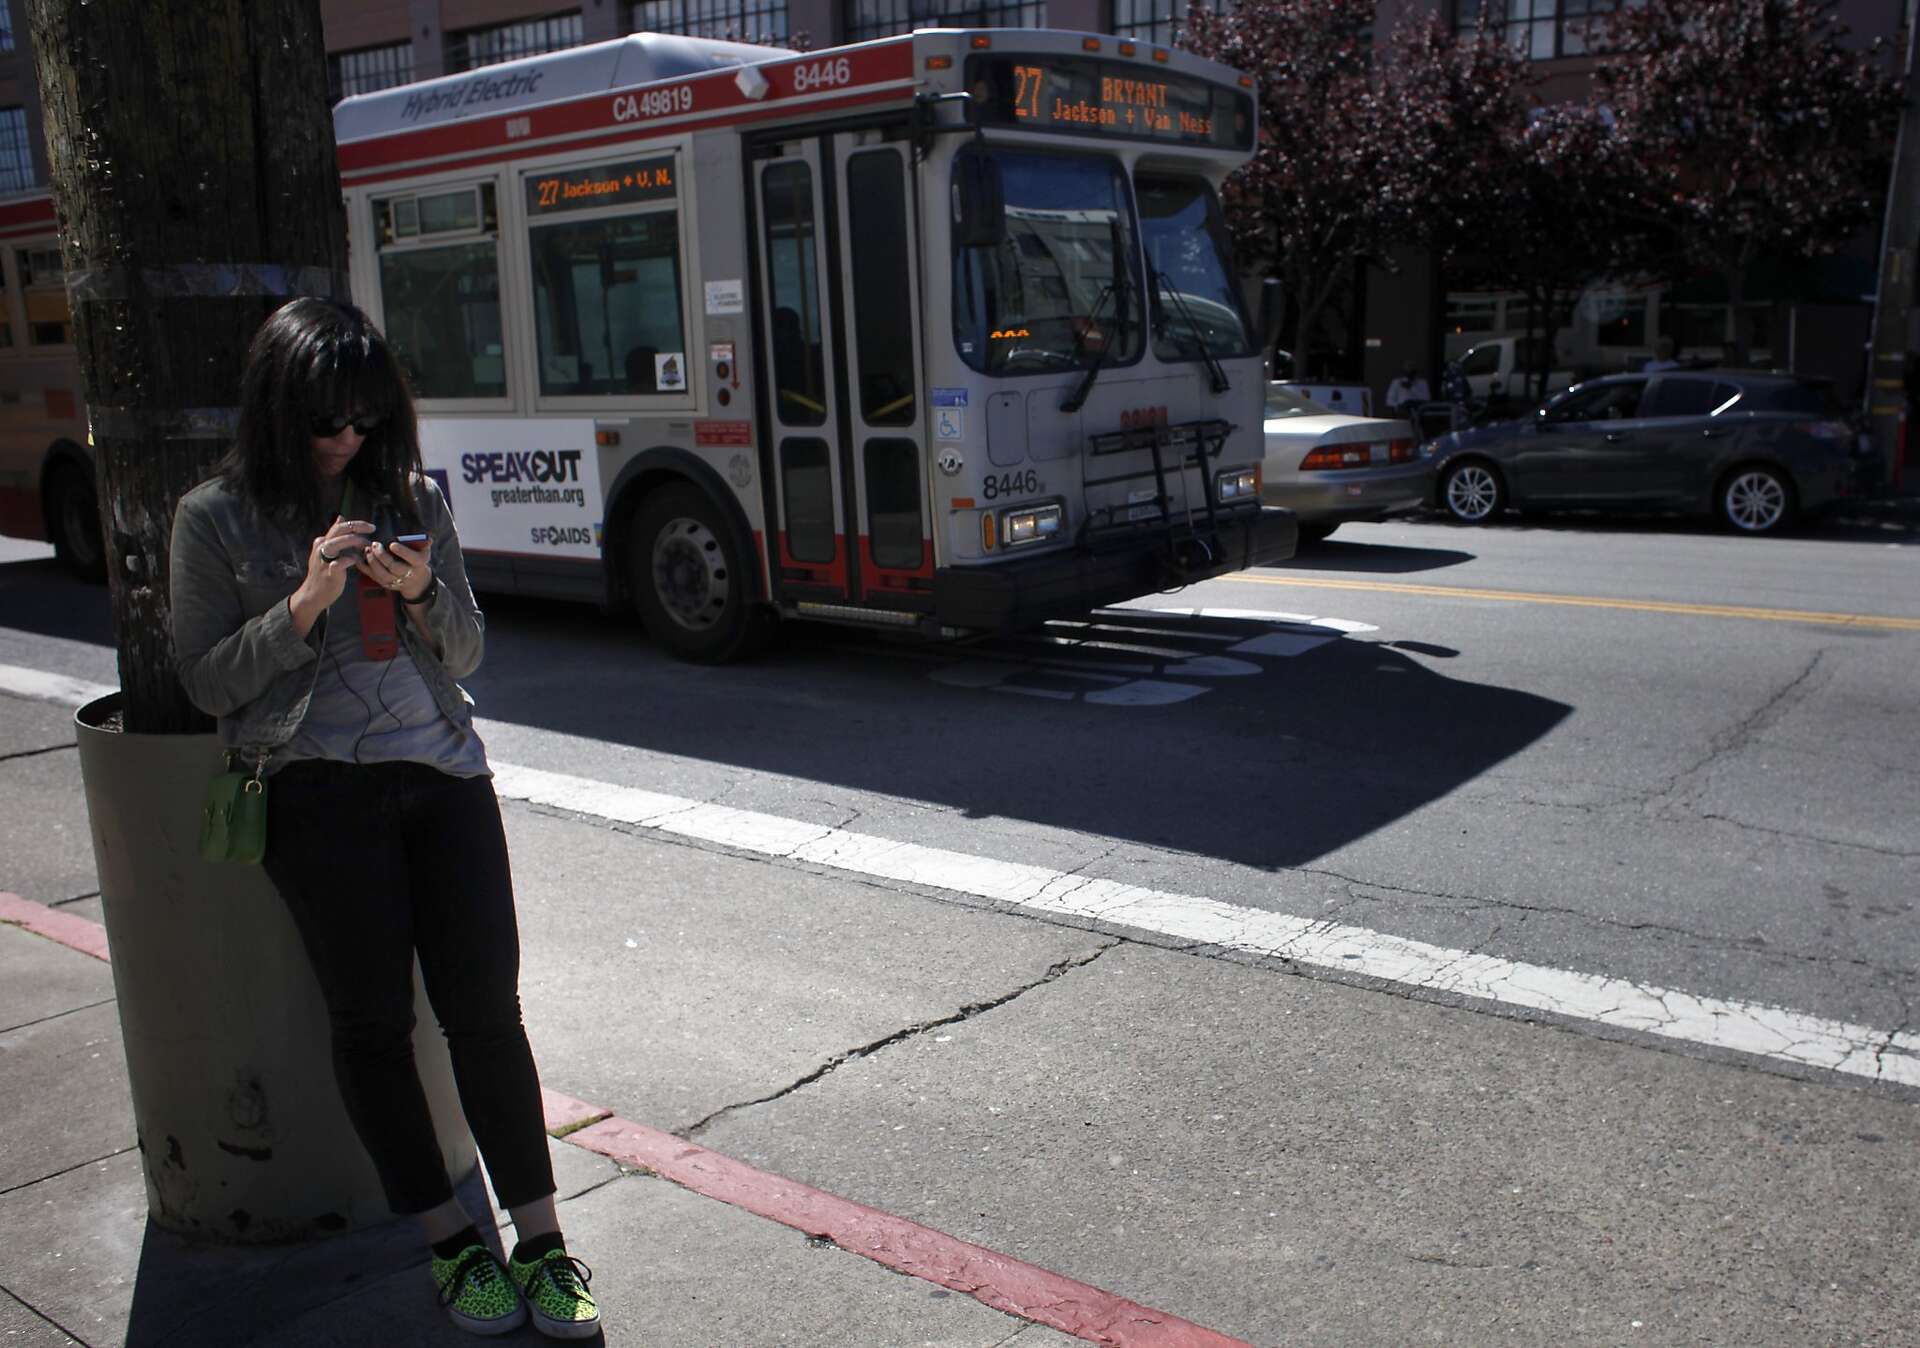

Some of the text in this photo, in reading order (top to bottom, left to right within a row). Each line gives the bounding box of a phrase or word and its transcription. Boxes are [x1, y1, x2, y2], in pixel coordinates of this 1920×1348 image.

[793, 57, 850, 91] 8446
[400, 70, 544, 121] Hybrid Electric
[612, 85, 693, 122] CA 49819
[1014, 66, 1042, 118] 27
[1103, 77, 1168, 108] BRYANT
[1053, 98, 1116, 125] Jackson
[1144, 108, 1171, 130] Van
[1179, 112, 1212, 134] Ness
[537, 179, 560, 206] 27
[562, 180, 620, 199] Jackson
[491, 486, 585, 508] greaterthan.org
[983, 469, 1038, 500] 8446
